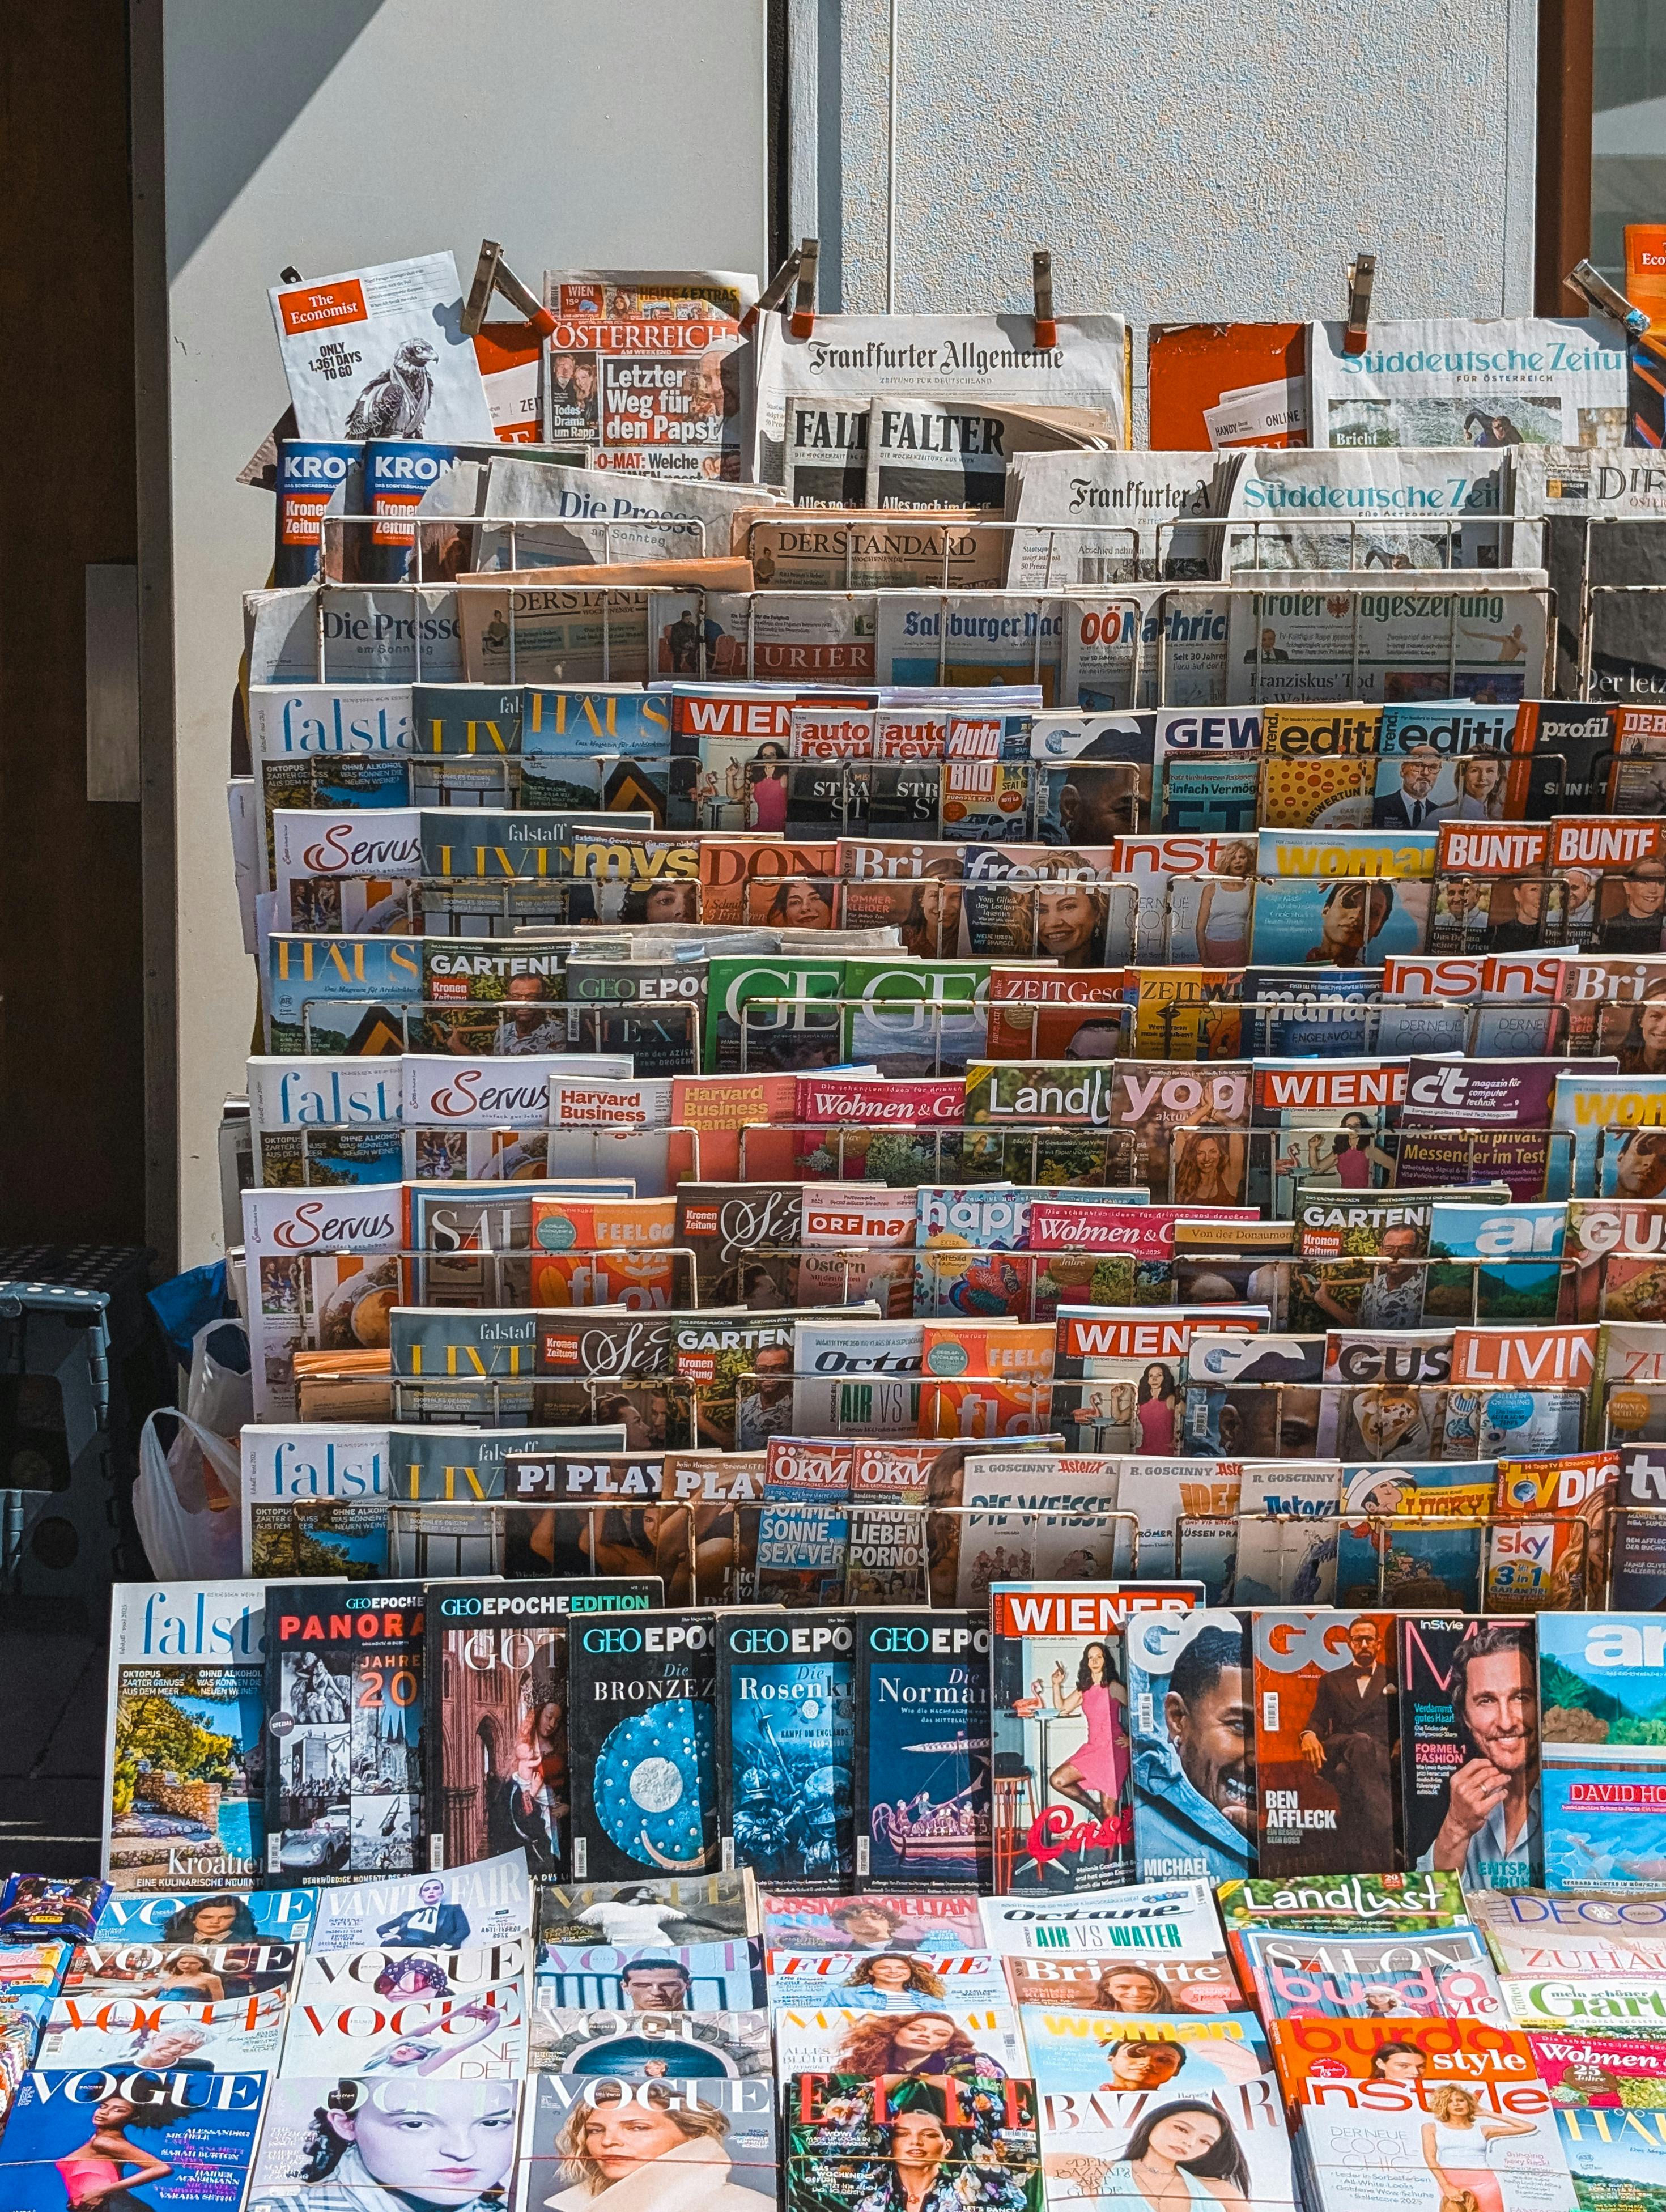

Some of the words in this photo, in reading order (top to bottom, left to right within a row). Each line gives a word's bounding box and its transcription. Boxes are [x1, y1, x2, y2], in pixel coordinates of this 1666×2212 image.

[309, 293, 334, 308] The
[568, 286, 594, 297] WIEN
[691, 288, 737, 302] EXTRAS
[290, 300, 358, 325] Economist
[552, 322, 728, 349] ÖSTERREICH
[320, 342, 345, 358] ONLY
[808, 341, 938, 375] Frankfurter
[940, 340, 1064, 375] Allgemeine
[308, 356, 335, 372] 1,361
[336, 351, 363, 365] DAYS
[1340, 350, 1544, 373] Süddeutsche
[323, 368, 337, 381] TO
[339, 366, 352, 378] GO
[607, 364, 686, 388] Letzter
[1457, 374, 1477, 382] FÜR
[1484, 374, 1553, 382] ÖSTERREICH
[554, 405, 584, 415] Todes-
[607, 390, 653, 419] Weg
[658, 390, 692, 414] für
[554, 416, 585, 427] Drama
[607, 416, 647, 439] den
[654, 416, 717, 444] Papst
[1216, 423, 1237, 436] HANDY
[1266, 410, 1300, 427] ONLINE
[554, 429, 569, 437] um
[571, 427, 594, 439] Rapp
[880, 411, 1005, 456] FALTER
[1337, 432, 1378, 446] Bricht
[649, 453, 699, 469] Welche
[1069, 478, 1188, 514] Frankfurter
[1243, 479, 1443, 509] Süddeutsche
[559, 490, 607, 519] Die
[613, 499, 703, 535] Presse
[613, 530, 665, 548] Sonntag
[904, 610, 1019, 642] Salburger
[741, 646, 869, 668] KURIER
[1264, 713, 1279, 754] trend.
[1542, 718, 1609, 741] profil
[509, 823, 567, 843] falstaff
[303, 824, 421, 872] Servus
[1007, 980, 1065, 1001] ZEIT
[1142, 981, 1201, 1001] ZEIT
[1411, 1067, 1469, 1105] c't
[1472, 1079, 1507, 1090] magazin
[1510, 1078, 1522, 1088] für
[560, 1090, 640, 1107] Harvard
[1467, 1098, 1496, 1108] technik
[1468, 1089, 1507, 1100] computer
[560, 1106, 646, 1122] Business
[815, 1094, 915, 1118] Wohnen
[917, 1104, 930, 1117] &
[1404, 1145, 1490, 1165] Messenger
[1492, 1146, 1509, 1163] im
[1516, 1148, 1545, 1164] Test
[274, 1202, 395, 1248] Servus
[685, 1220, 717, 1232] Zeitung
[686, 1211, 717, 1222] Kronen
[811, 1215, 859, 1232] ORF
[1039, 1218, 1140, 1243] Wohnen
[1192, 1228, 1212, 1238] Von
[1216, 1228, 1232, 1239] der
[679, 1358, 713, 1368] Kronen
[678, 1368, 712, 1381] Zeitung
[774, 1446, 851, 1482] ÖKM
[989, 1463, 1055, 1474] GOSCINNY
[1059, 1460, 1106, 1474] Asterix
[970, 1495, 1010, 1526] DIE
[1018, 1495, 1111, 1526] WEISSE
[762, 1520, 835, 1546] SONNE,
[851, 1524, 919, 1545] LIEBEN
[1137, 1530, 1172, 1539] RÖMER
[1497, 1532, 1549, 1559] sky
[850, 1546, 929, 1567] PORNOS
[1494, 1566, 1514, 1585] 3
[1516, 1573, 1529, 1583] in
[1529, 1567, 1543, 1584] 1
[346, 1598, 370, 1609] GEO
[441, 1598, 481, 1615] GEO
[483, 1596, 570, 1615] EPOCHE
[571, 1595, 649, 1612] EDITION
[1420, 1620, 1463, 1631] InStyle
[730, 1628, 788, 1653] GEO
[360, 1654, 421, 1669] JAHRE
[663, 1663, 690, 1678] Die
[215, 1678, 247, 1687] KÖNNEN
[797, 1665, 824, 1681] Die
[358, 1672, 418, 1707] 20
[1414, 1704, 1452, 1715] Verdammt
[1414, 1715, 1435, 1724] gutes
[1436, 1713, 1455, 1723] Haar!
[1415, 1754, 1463, 1764] FASHION
[1416, 1744, 1456, 1754] FORMEL
[1461, 1744, 1466, 1754] 1
[1265, 1790, 1298, 1810] BEN
[1570, 1785, 1633, 1803] DAVID
[1266, 1809, 1337, 1829] AFFLECK
[1144, 1858, 1210, 1876] MICHAEL
[1003, 1904, 1195, 1921] Octane
[1036, 1926, 1070, 1948] AIR
[1074, 1926, 1103, 1949] VS
[1109, 1923, 1182, 1949] WATER
[1266, 1942, 1461, 1974] SALON
[1551, 1989, 1586, 1998] mein
[1591, 1987, 1648, 1998] schöner
[303, 1982, 521, 2037] VOGUE
[1042, 2014, 1244, 2043] woman
[1433, 2048, 1527, 2076] style
[1537, 2042, 1659, 2069] Wohnen
[1573, 2065, 1600, 2077] 25
[1575, 2073, 1606, 2082] Jahre
[32, 2071, 261, 2111] VOGUE
[549, 2076, 770, 2113] VOGUE
[800, 2074, 1036, 2131] ELLE
[1331, 2126, 1359, 2139] DER
[1361, 2128, 1407, 2140] NEUE
